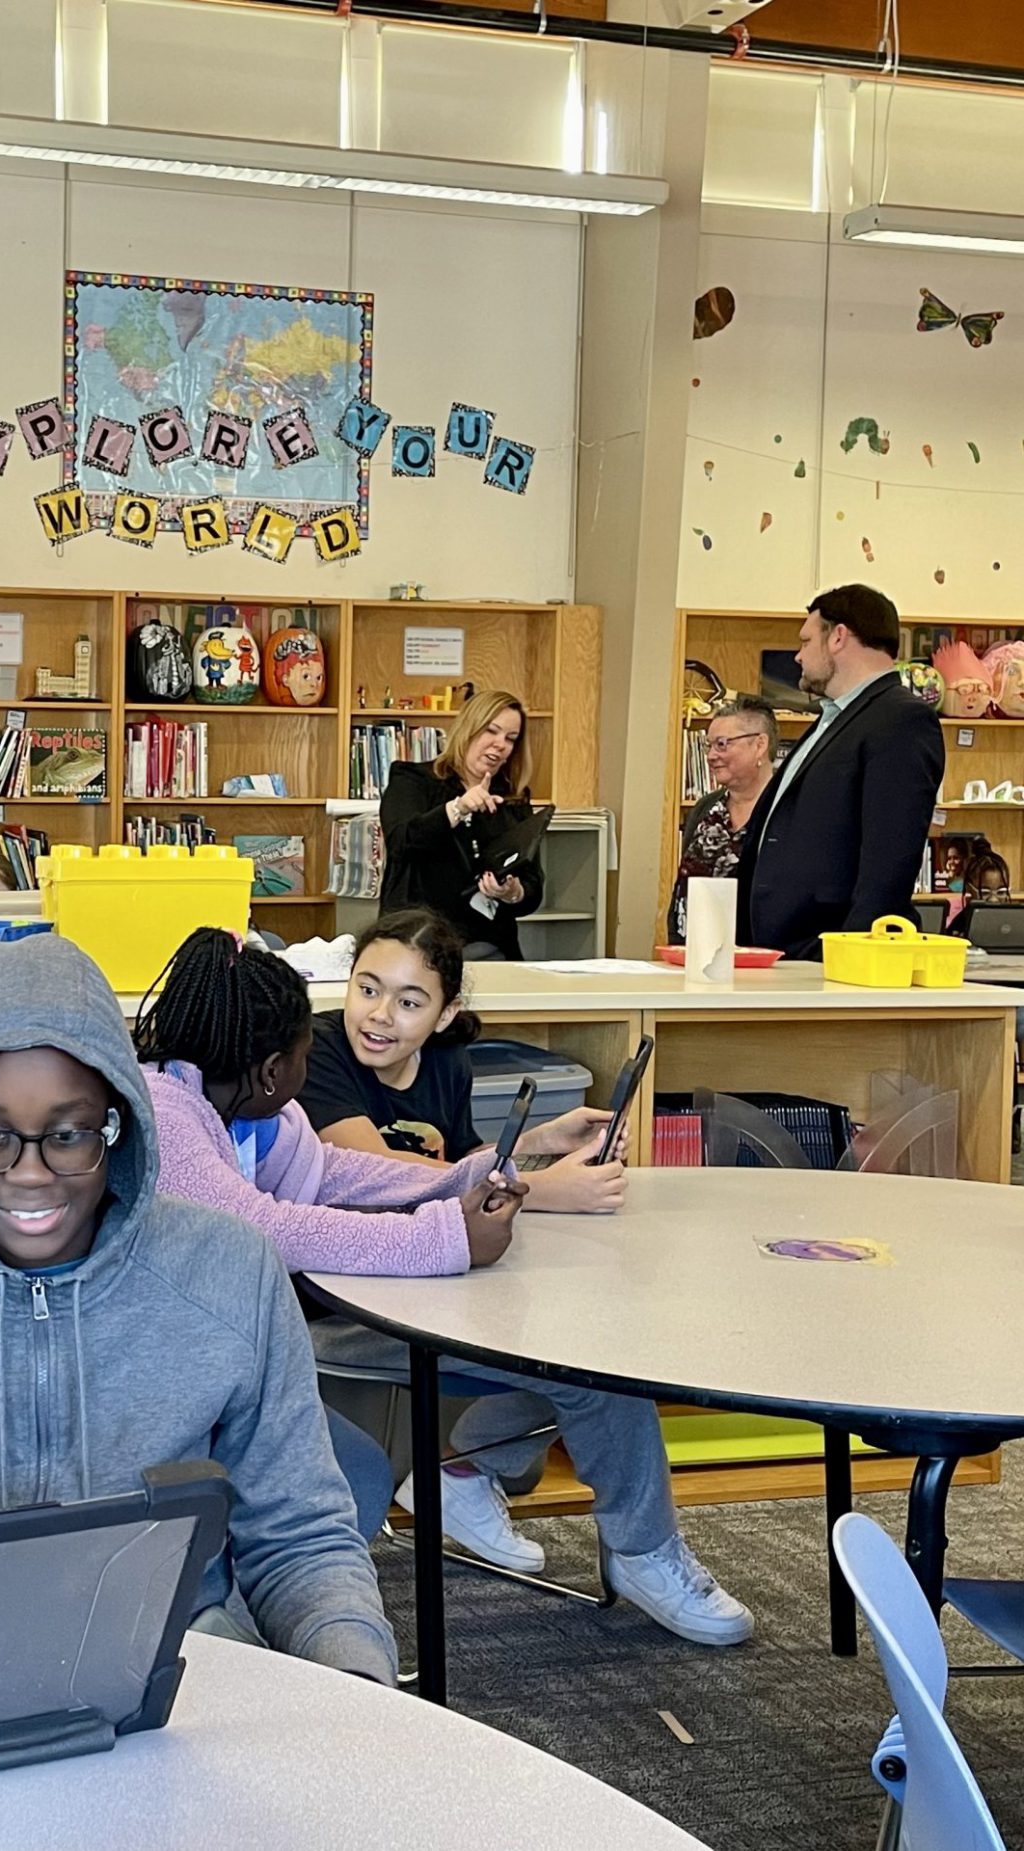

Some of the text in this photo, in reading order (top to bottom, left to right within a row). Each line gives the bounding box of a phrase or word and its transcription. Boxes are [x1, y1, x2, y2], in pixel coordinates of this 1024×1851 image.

[355, 406, 524, 486] YOUR
[43, 496, 350, 552] WORLD
[31, 728, 102, 756] Reptiles
[31, 783, 49, 793] and
